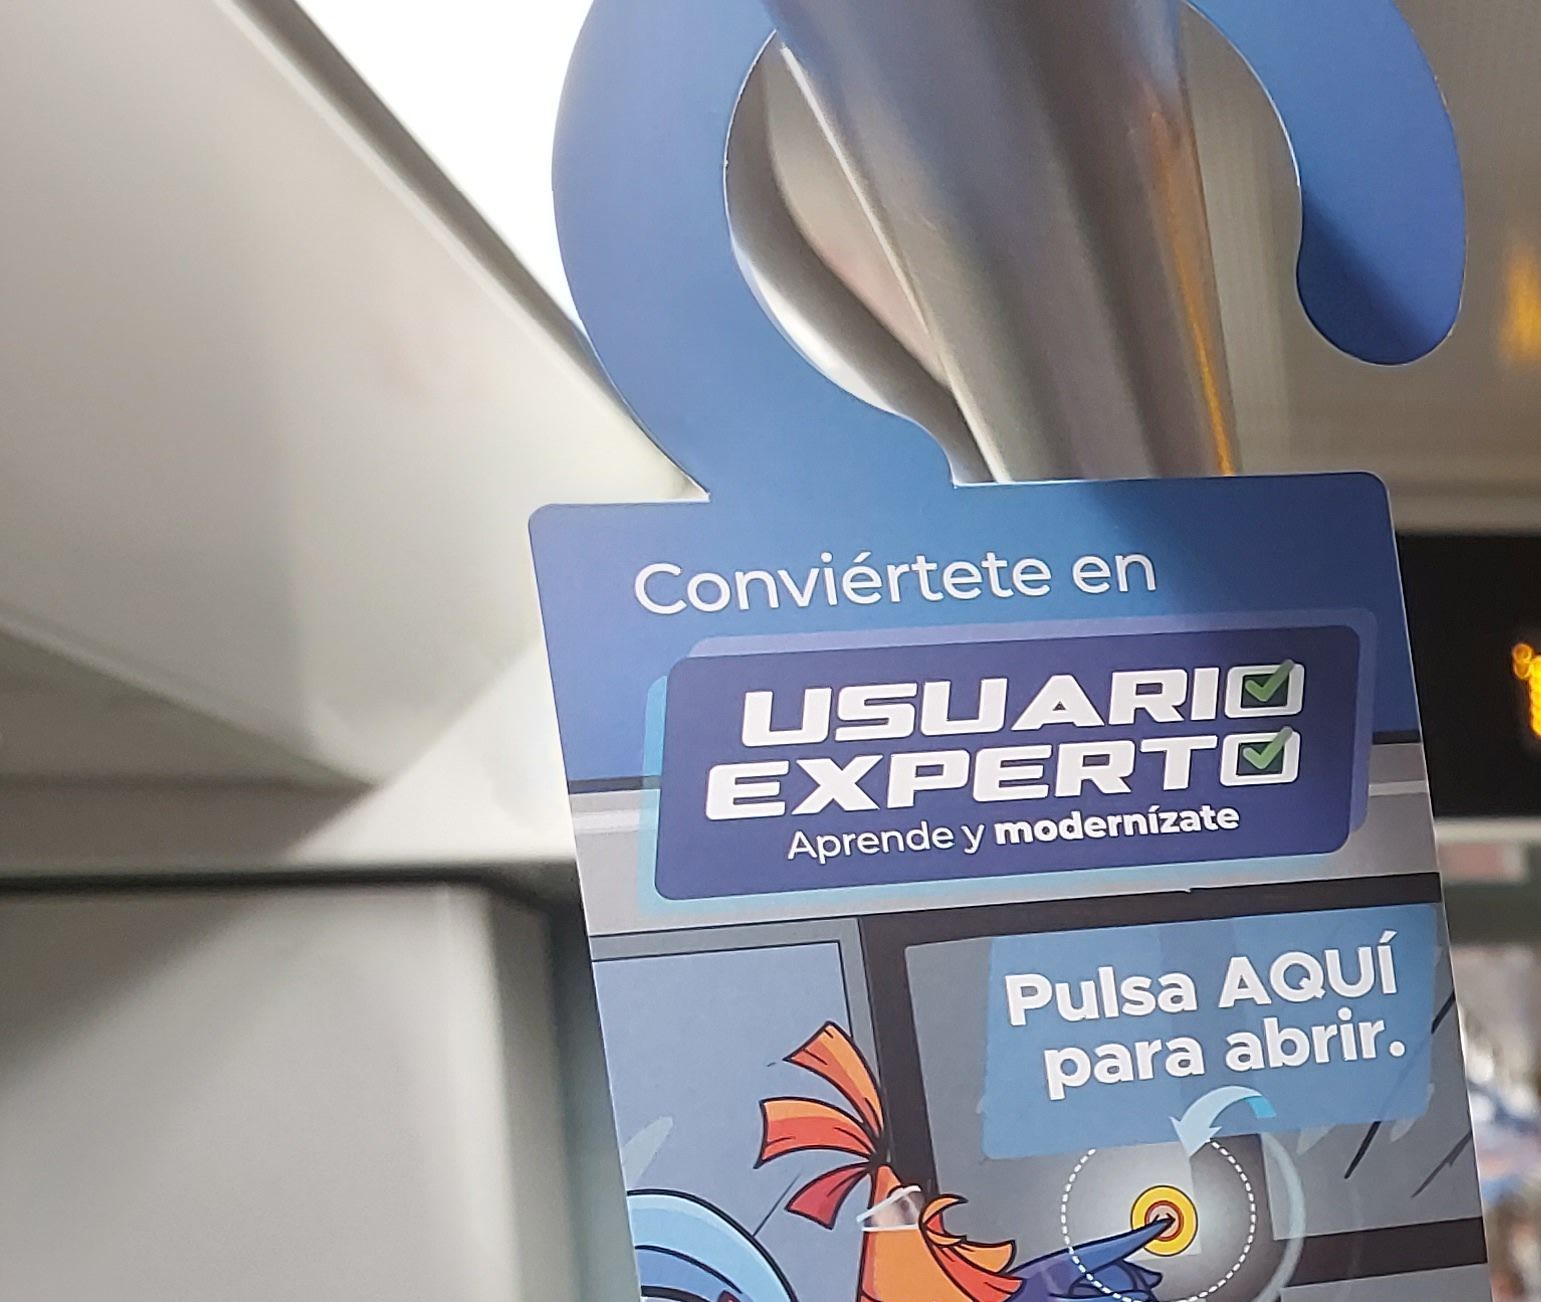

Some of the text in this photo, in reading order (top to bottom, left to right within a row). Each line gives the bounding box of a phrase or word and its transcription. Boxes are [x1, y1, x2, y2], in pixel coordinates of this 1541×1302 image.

[633, 550, 1156, 615] Conviértete en
[742, 662, 1305, 748] USUARIO
[705, 727, 1301, 821] EXPERTO
[786, 803, 1240, 865] Aprende y modernízate
[1003, 930, 1398, 1027] Pulsa AQUÍ
[1042, 1007, 1406, 1102] para abrir.
